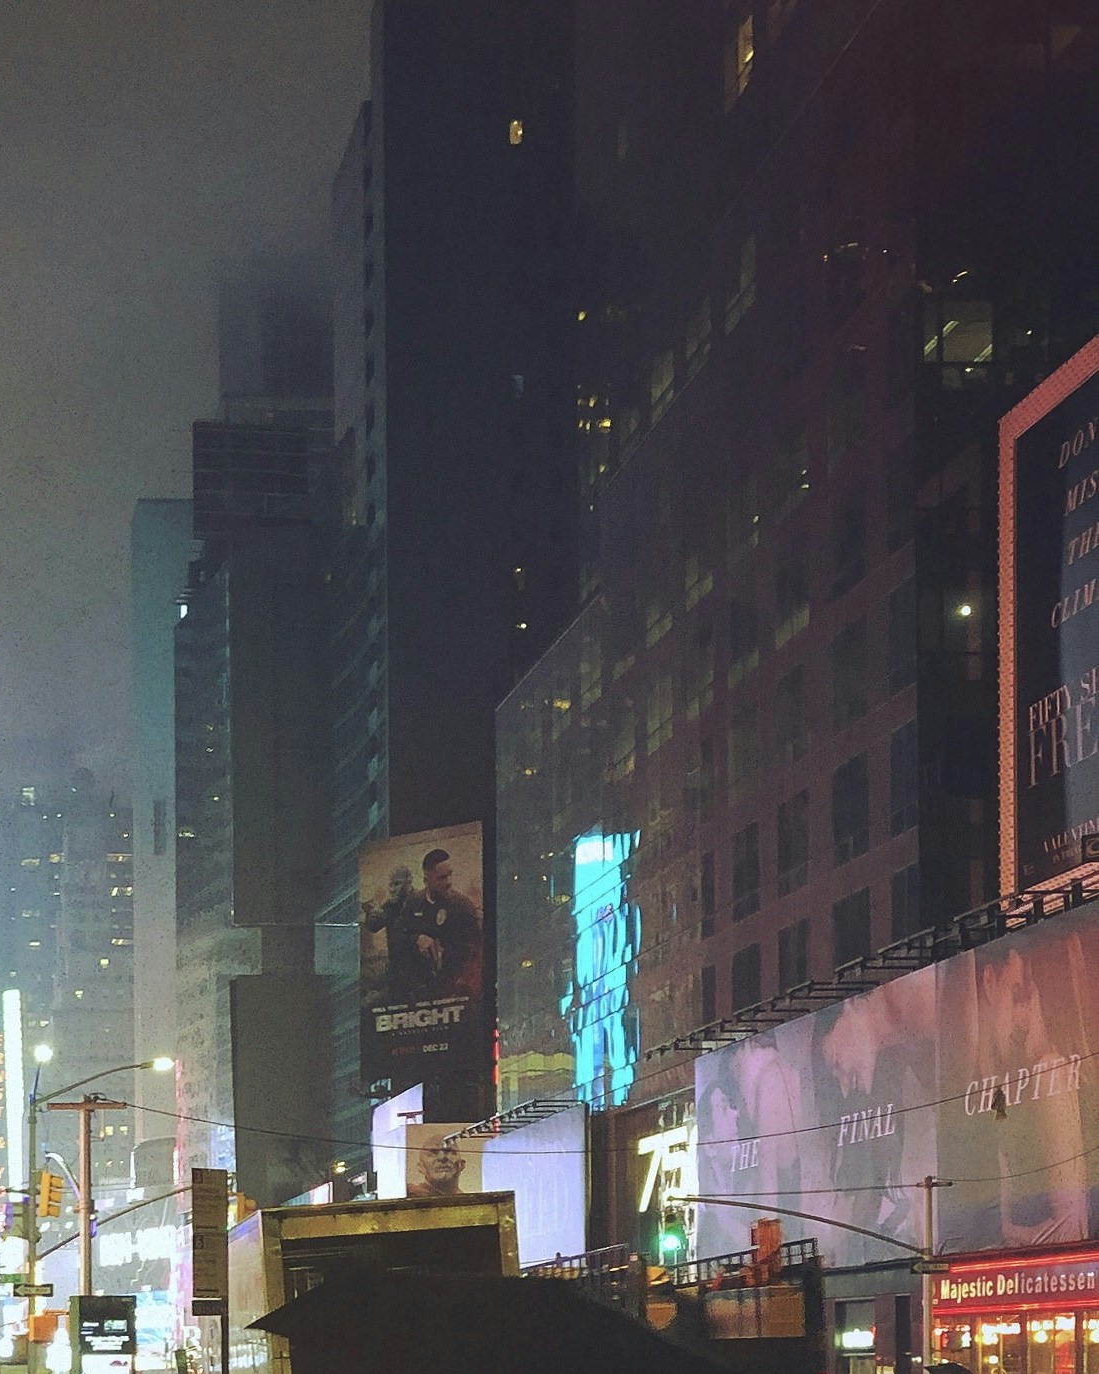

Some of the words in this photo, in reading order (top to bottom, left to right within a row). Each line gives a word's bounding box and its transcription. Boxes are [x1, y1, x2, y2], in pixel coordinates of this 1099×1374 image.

[1029, 684, 1071, 733] FIFTY
[375, 1004, 465, 1033] BRIGHT
[422, 1044, 439, 1053] DEC
[439, 1042, 449, 1051] 22
[730, 1138, 760, 1172] THE
[836, 1103, 895, 1147] FINAL
[964, 1053, 1081, 1117] CHAPTER
[940, 1275, 994, 1303] Majestic
[996, 1271, 1096, 1296] Delicatessen
